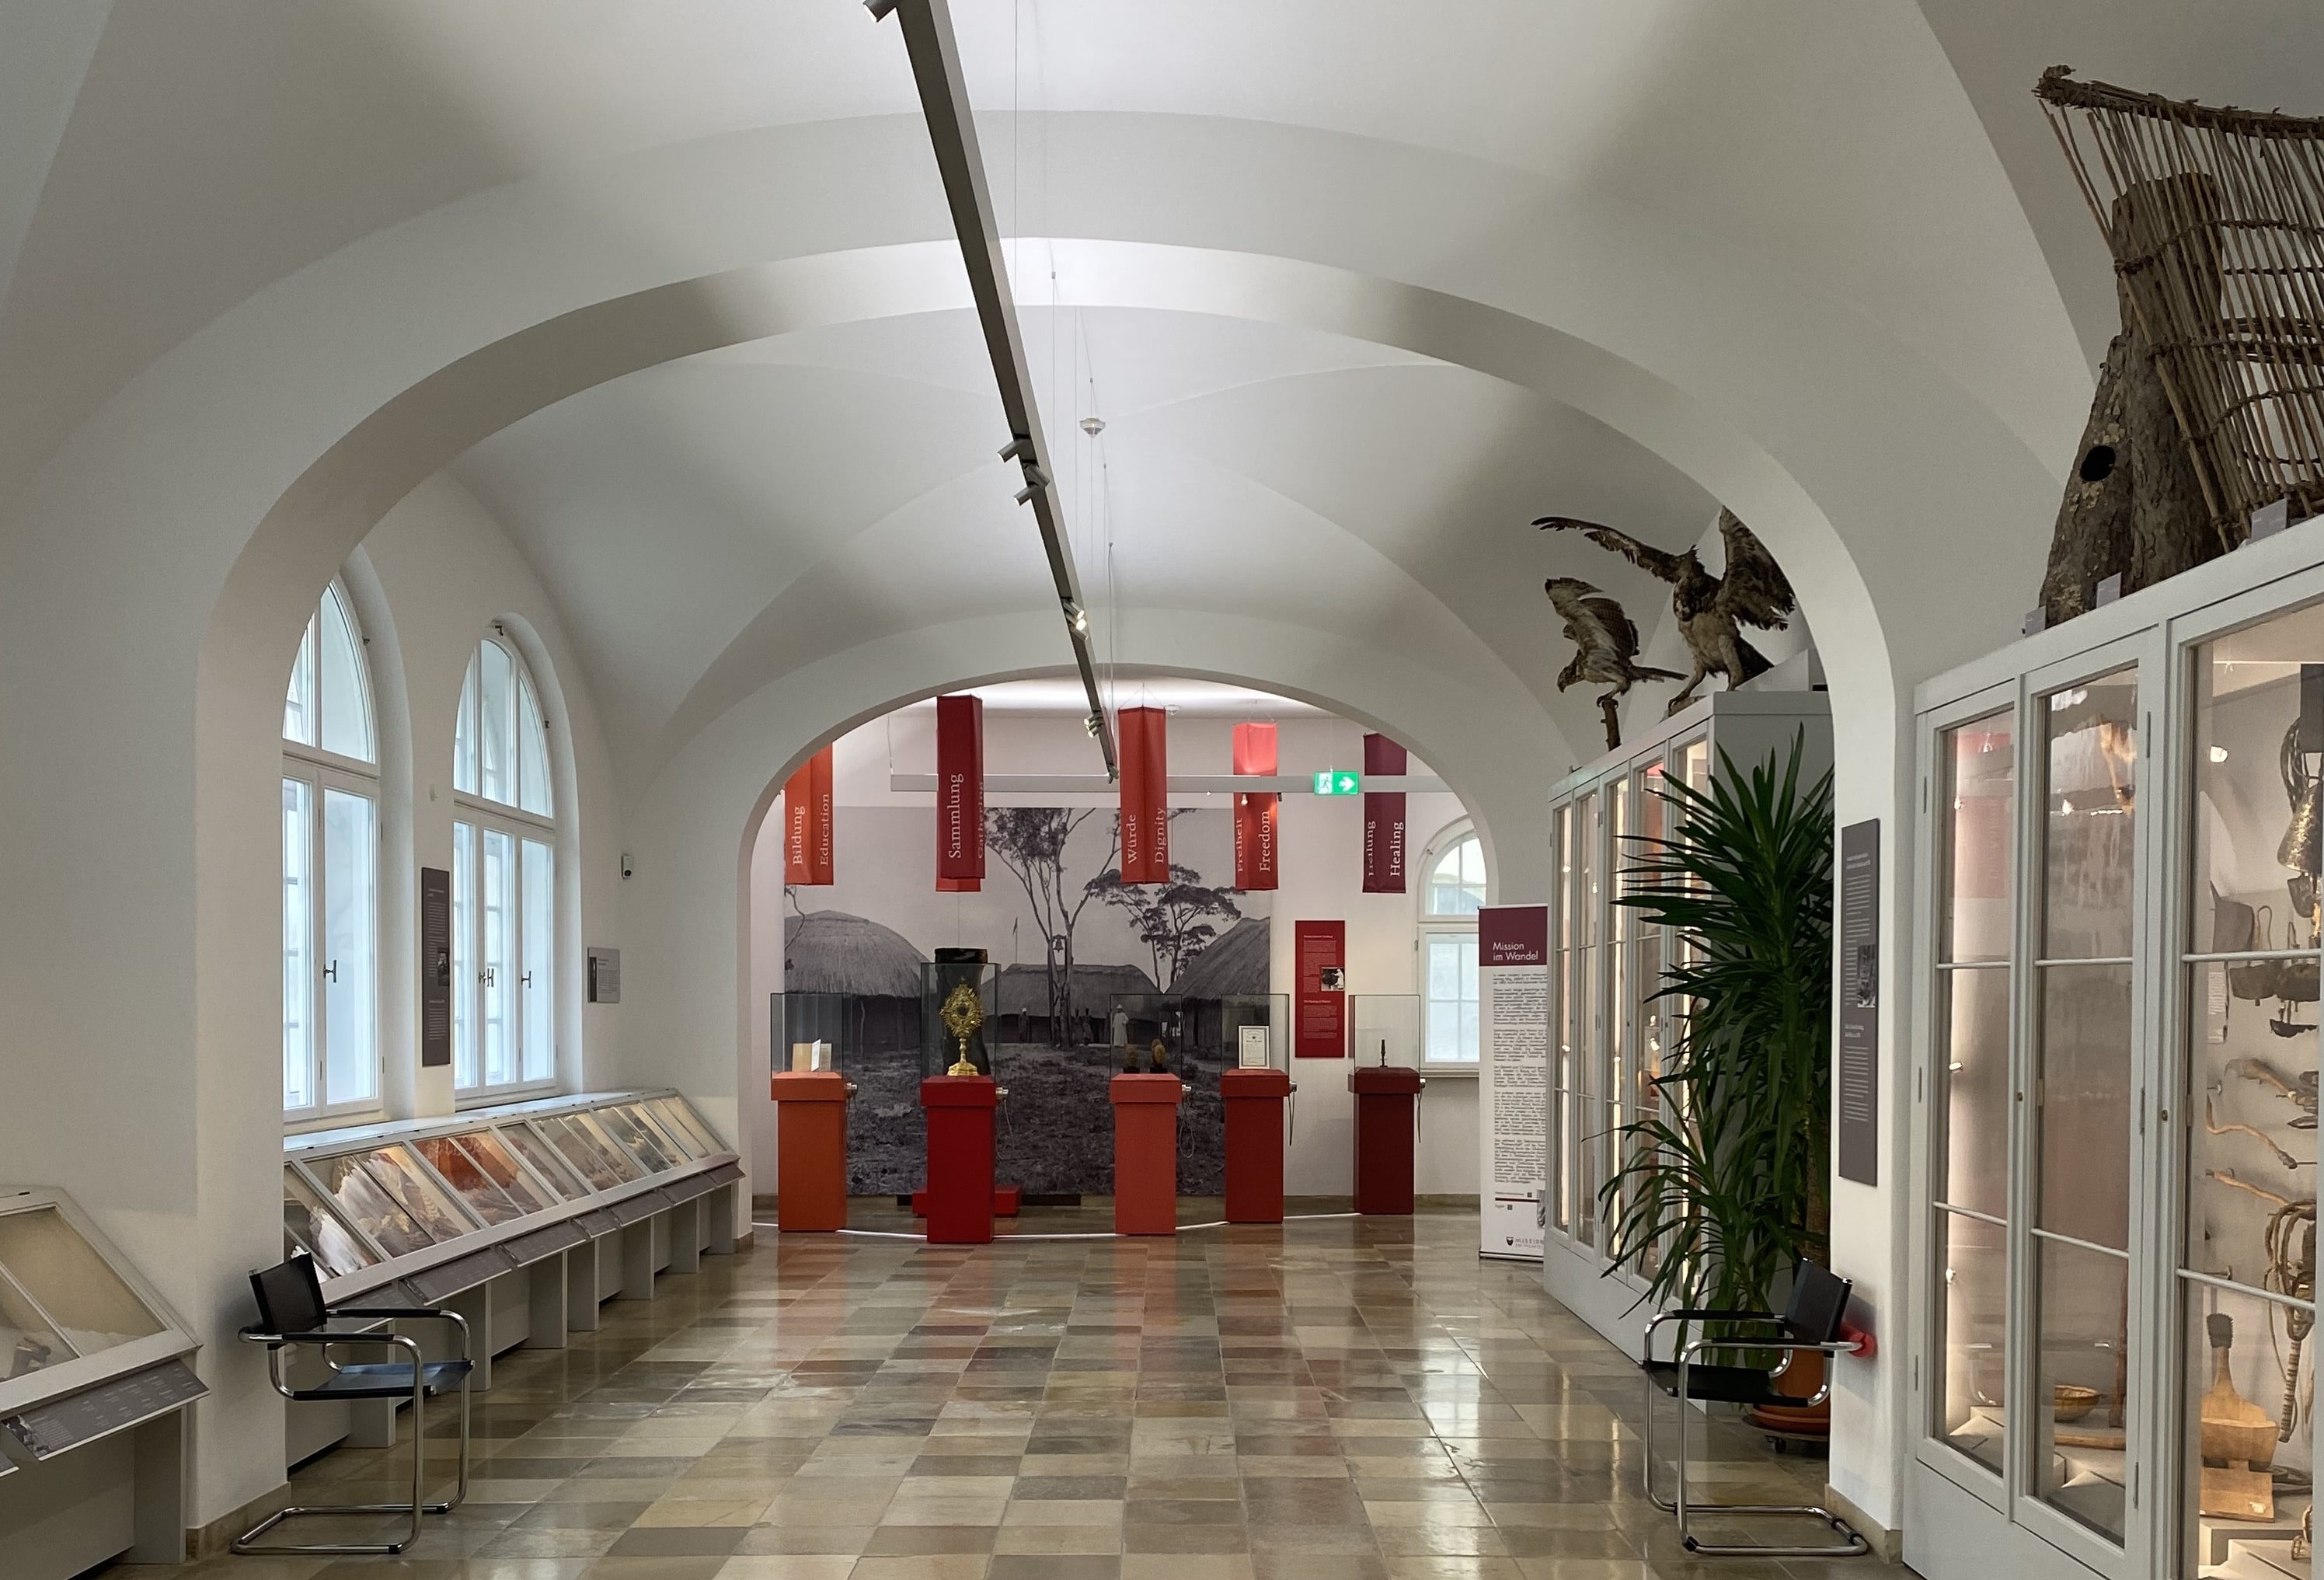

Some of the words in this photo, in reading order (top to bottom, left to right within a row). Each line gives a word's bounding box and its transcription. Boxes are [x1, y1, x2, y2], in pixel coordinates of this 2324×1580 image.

[792, 806, 806, 866] Bildung
[820, 793, 830, 866] Education
[946, 773, 964, 859] Sammlung
[1127, 814, 1137, 864] Würde
[1155, 807, 1166, 864] Dignity
[1258, 811, 1270, 872] Freedom
[1390, 821, 1404, 877] Healing
[1493, 941, 1524, 950] Mission
[1493, 953, 1503, 961] im
[1505, 950, 1538, 961] Wandel
